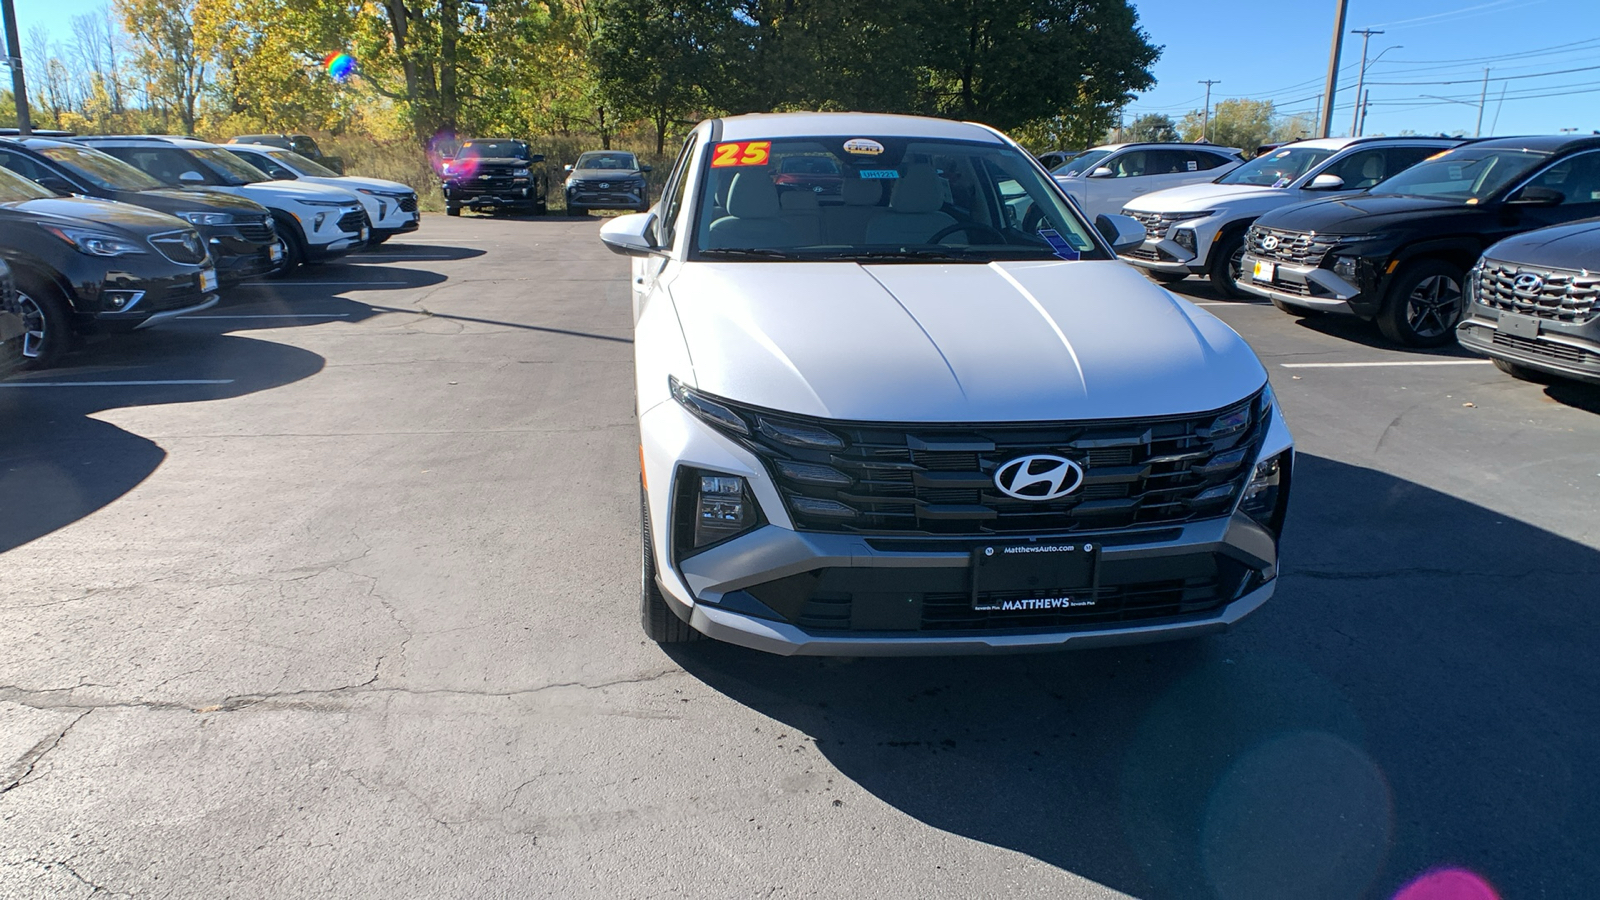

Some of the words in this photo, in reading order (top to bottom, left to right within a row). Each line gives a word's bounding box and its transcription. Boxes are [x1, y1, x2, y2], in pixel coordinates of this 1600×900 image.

[712, 142, 769, 166] 25
[1004, 545, 1074, 554] MatthewsAuto.com
[1002, 598, 1069, 610] MATTHEWS
